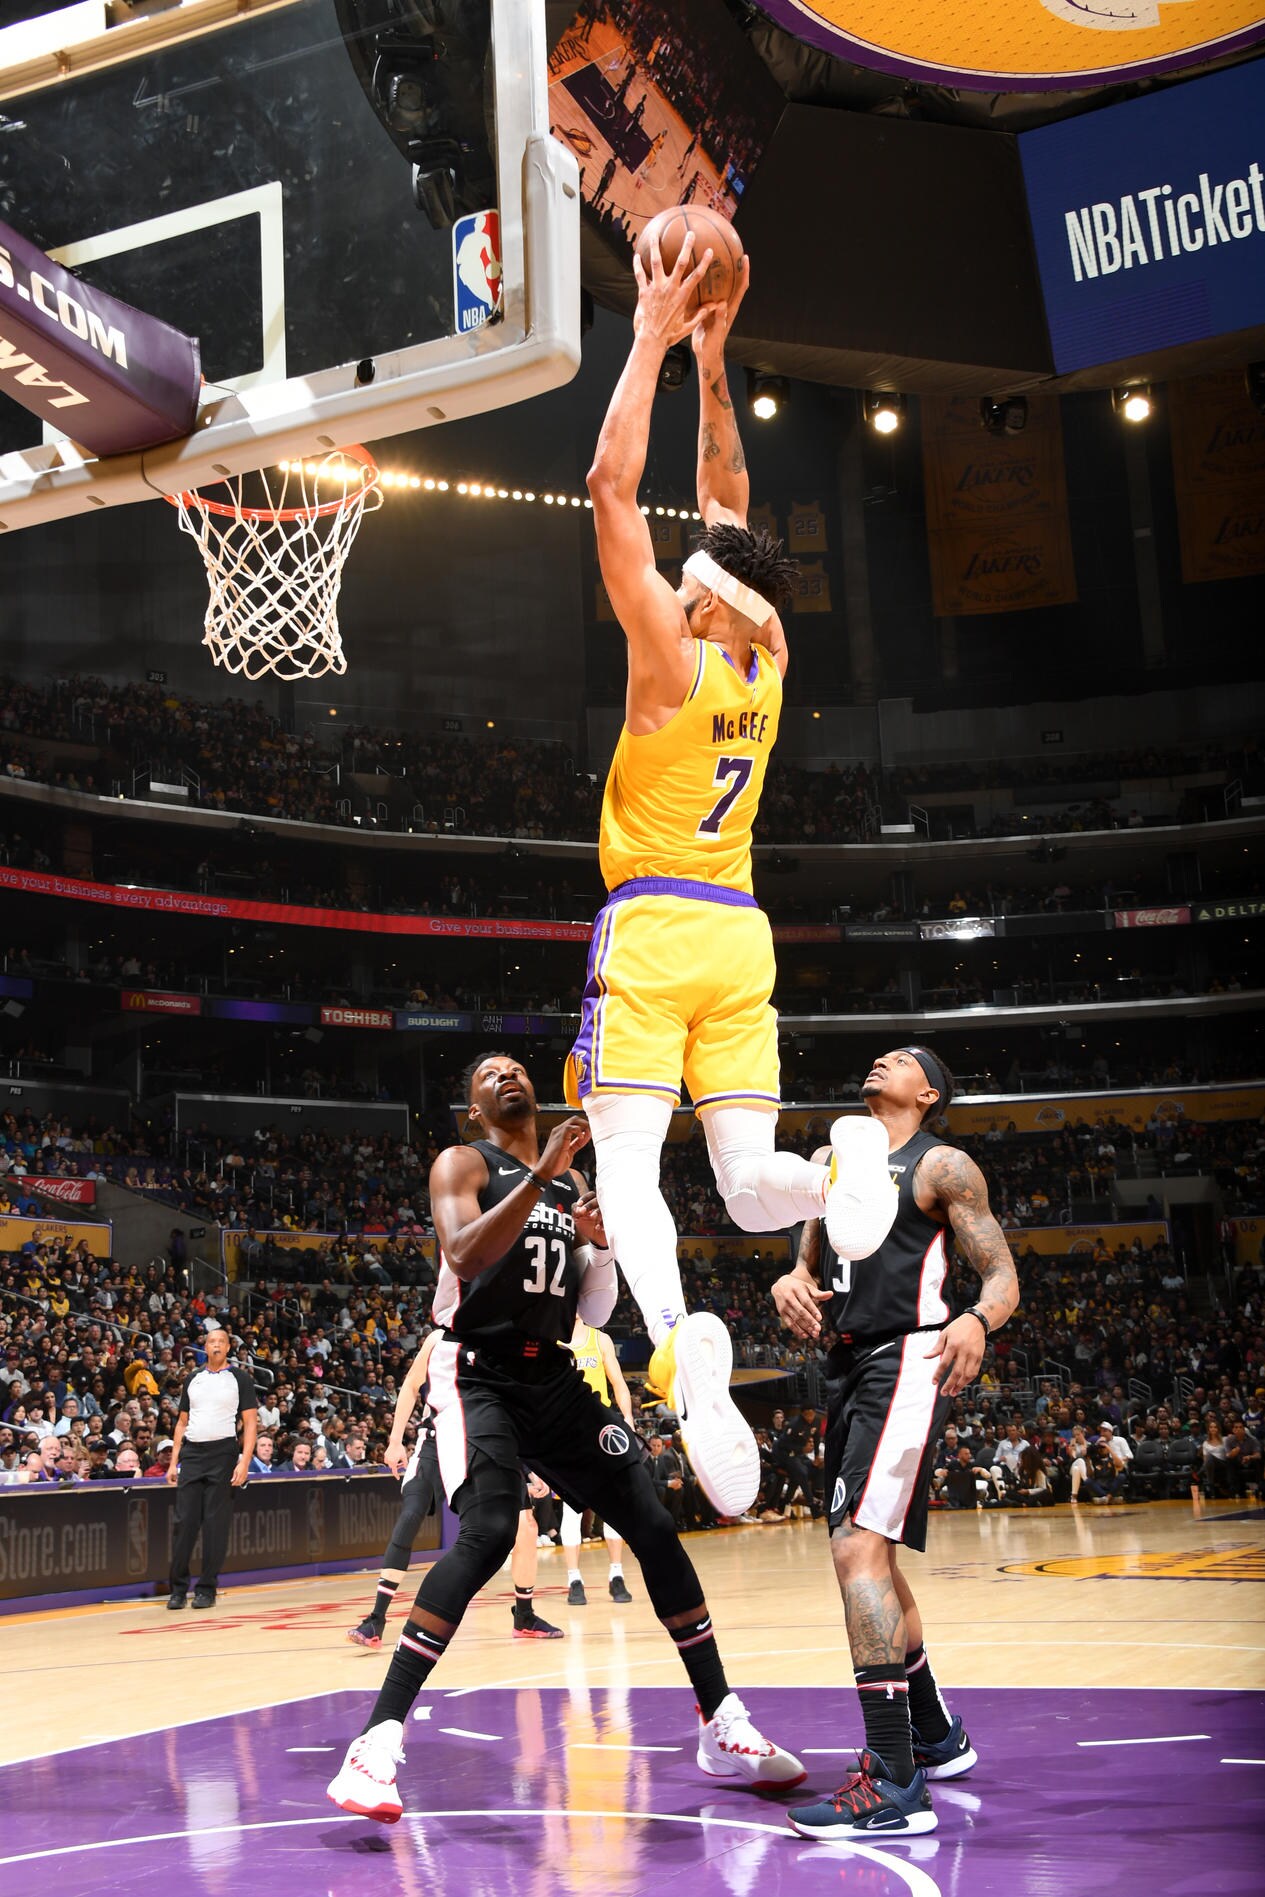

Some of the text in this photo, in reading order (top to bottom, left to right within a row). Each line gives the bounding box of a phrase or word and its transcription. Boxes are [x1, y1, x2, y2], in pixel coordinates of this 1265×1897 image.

[463, 305, 487, 329] NBA
[795, 519, 819, 537] 25
[695, 755, 755, 841] 7
[22, 876, 51, 890] your
[54, 879, 112, 900] business
[114, 892, 151, 907] every
[154, 895, 231, 915] advantage.
[1215, 902, 1265, 918] DELTA
[429, 919, 590, 939] Give your business every
[147, 999, 192, 1009] McDonald's
[322, 1009, 391, 1026] TOSHIBA
[407, 1018, 460, 1027] BUD LIGHT
[482, 1015, 503, 1025] ANH
[482, 1024, 502, 1033] VAN
[226, 1234, 247, 1248] 10
[523, 1236, 566, 1297] 32
